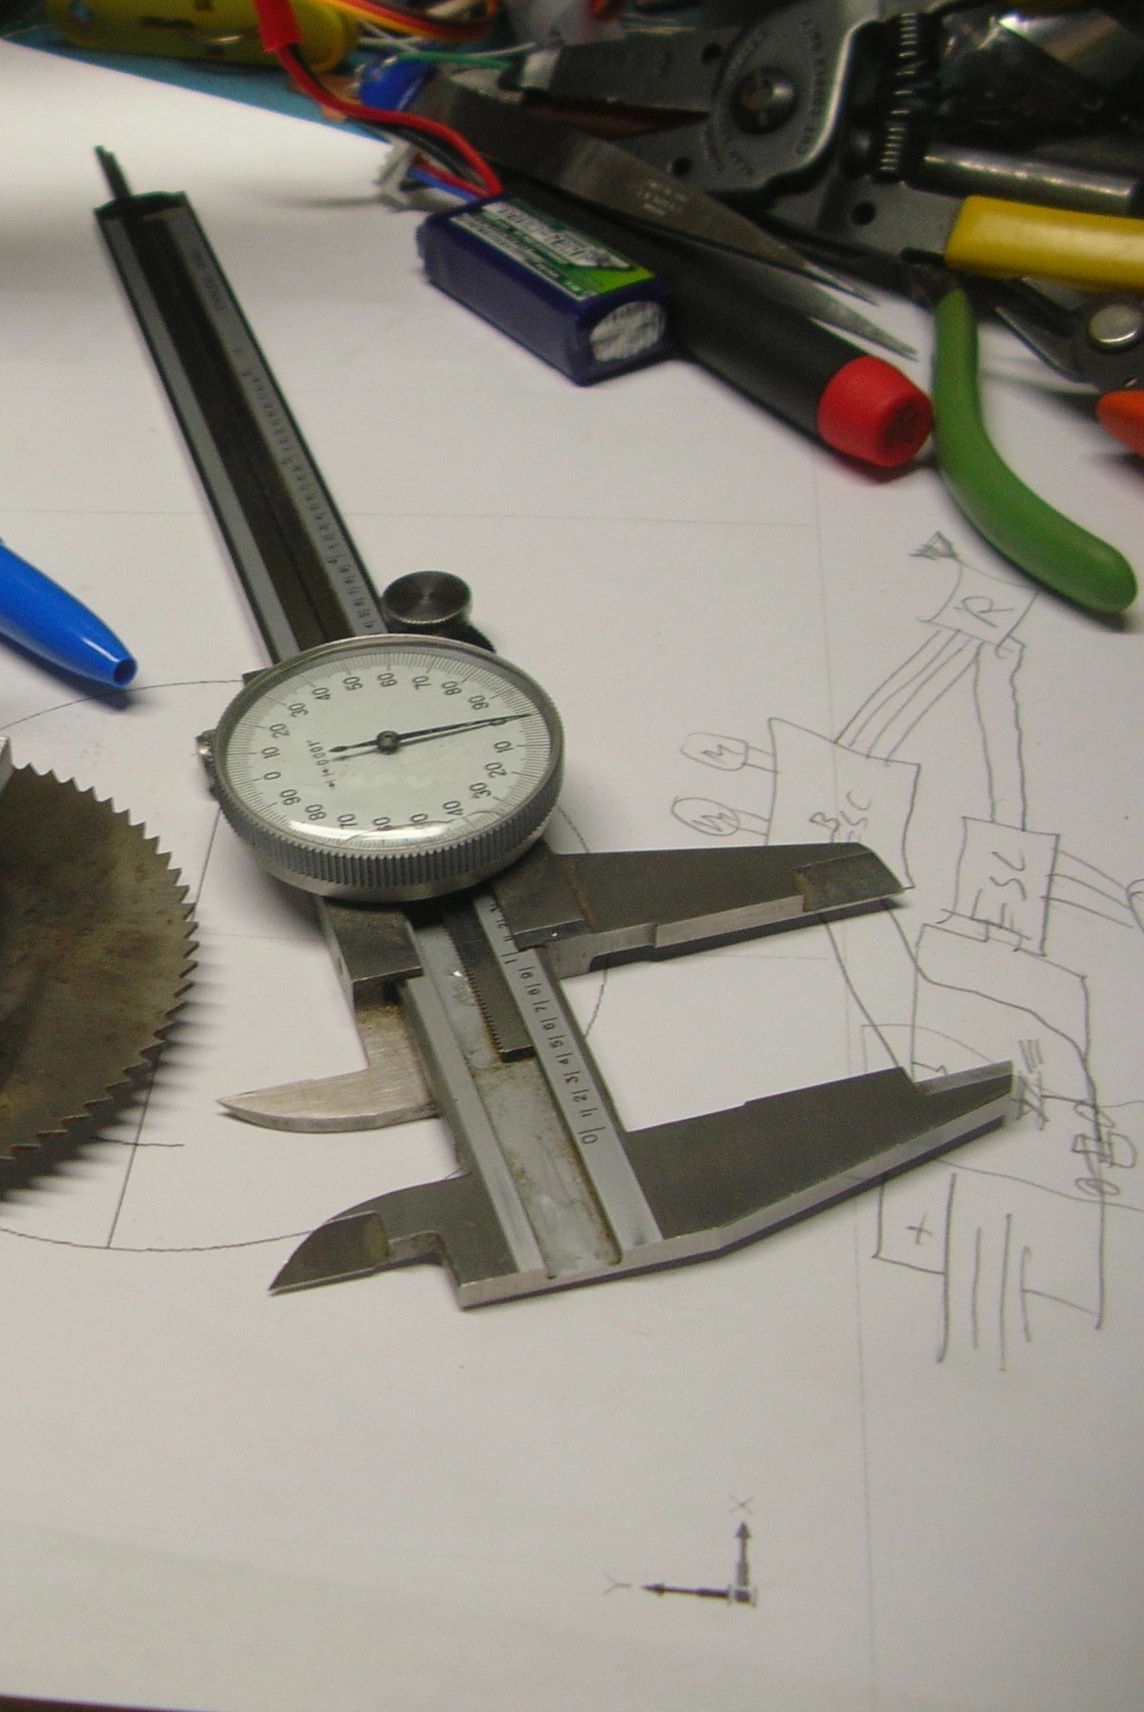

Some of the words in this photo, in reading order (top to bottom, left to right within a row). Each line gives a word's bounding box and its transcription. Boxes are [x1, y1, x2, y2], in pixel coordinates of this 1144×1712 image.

[342, 675, 363, 691] 50
[377, 672, 398, 688] 60
[411, 675, 432, 690] 70
[312, 686, 331, 701] 40
[441, 680, 461, 697] 80
[288, 702, 309, 718] 30
[468, 695, 489, 711] 90
[269, 723, 290, 739] 20
[261, 746, 280, 760] 10
[493, 740, 512, 754] 10
[264, 771, 281, 781] 0
[484, 762, 507, 778] 20
[279, 789, 301, 807] 90
[469, 782, 492, 800] 30
[305, 804, 327, 821] 80
[442, 800, 465, 817] 40
[338, 813, 359, 829] 70
[581, 1134, 598, 1144] 0
